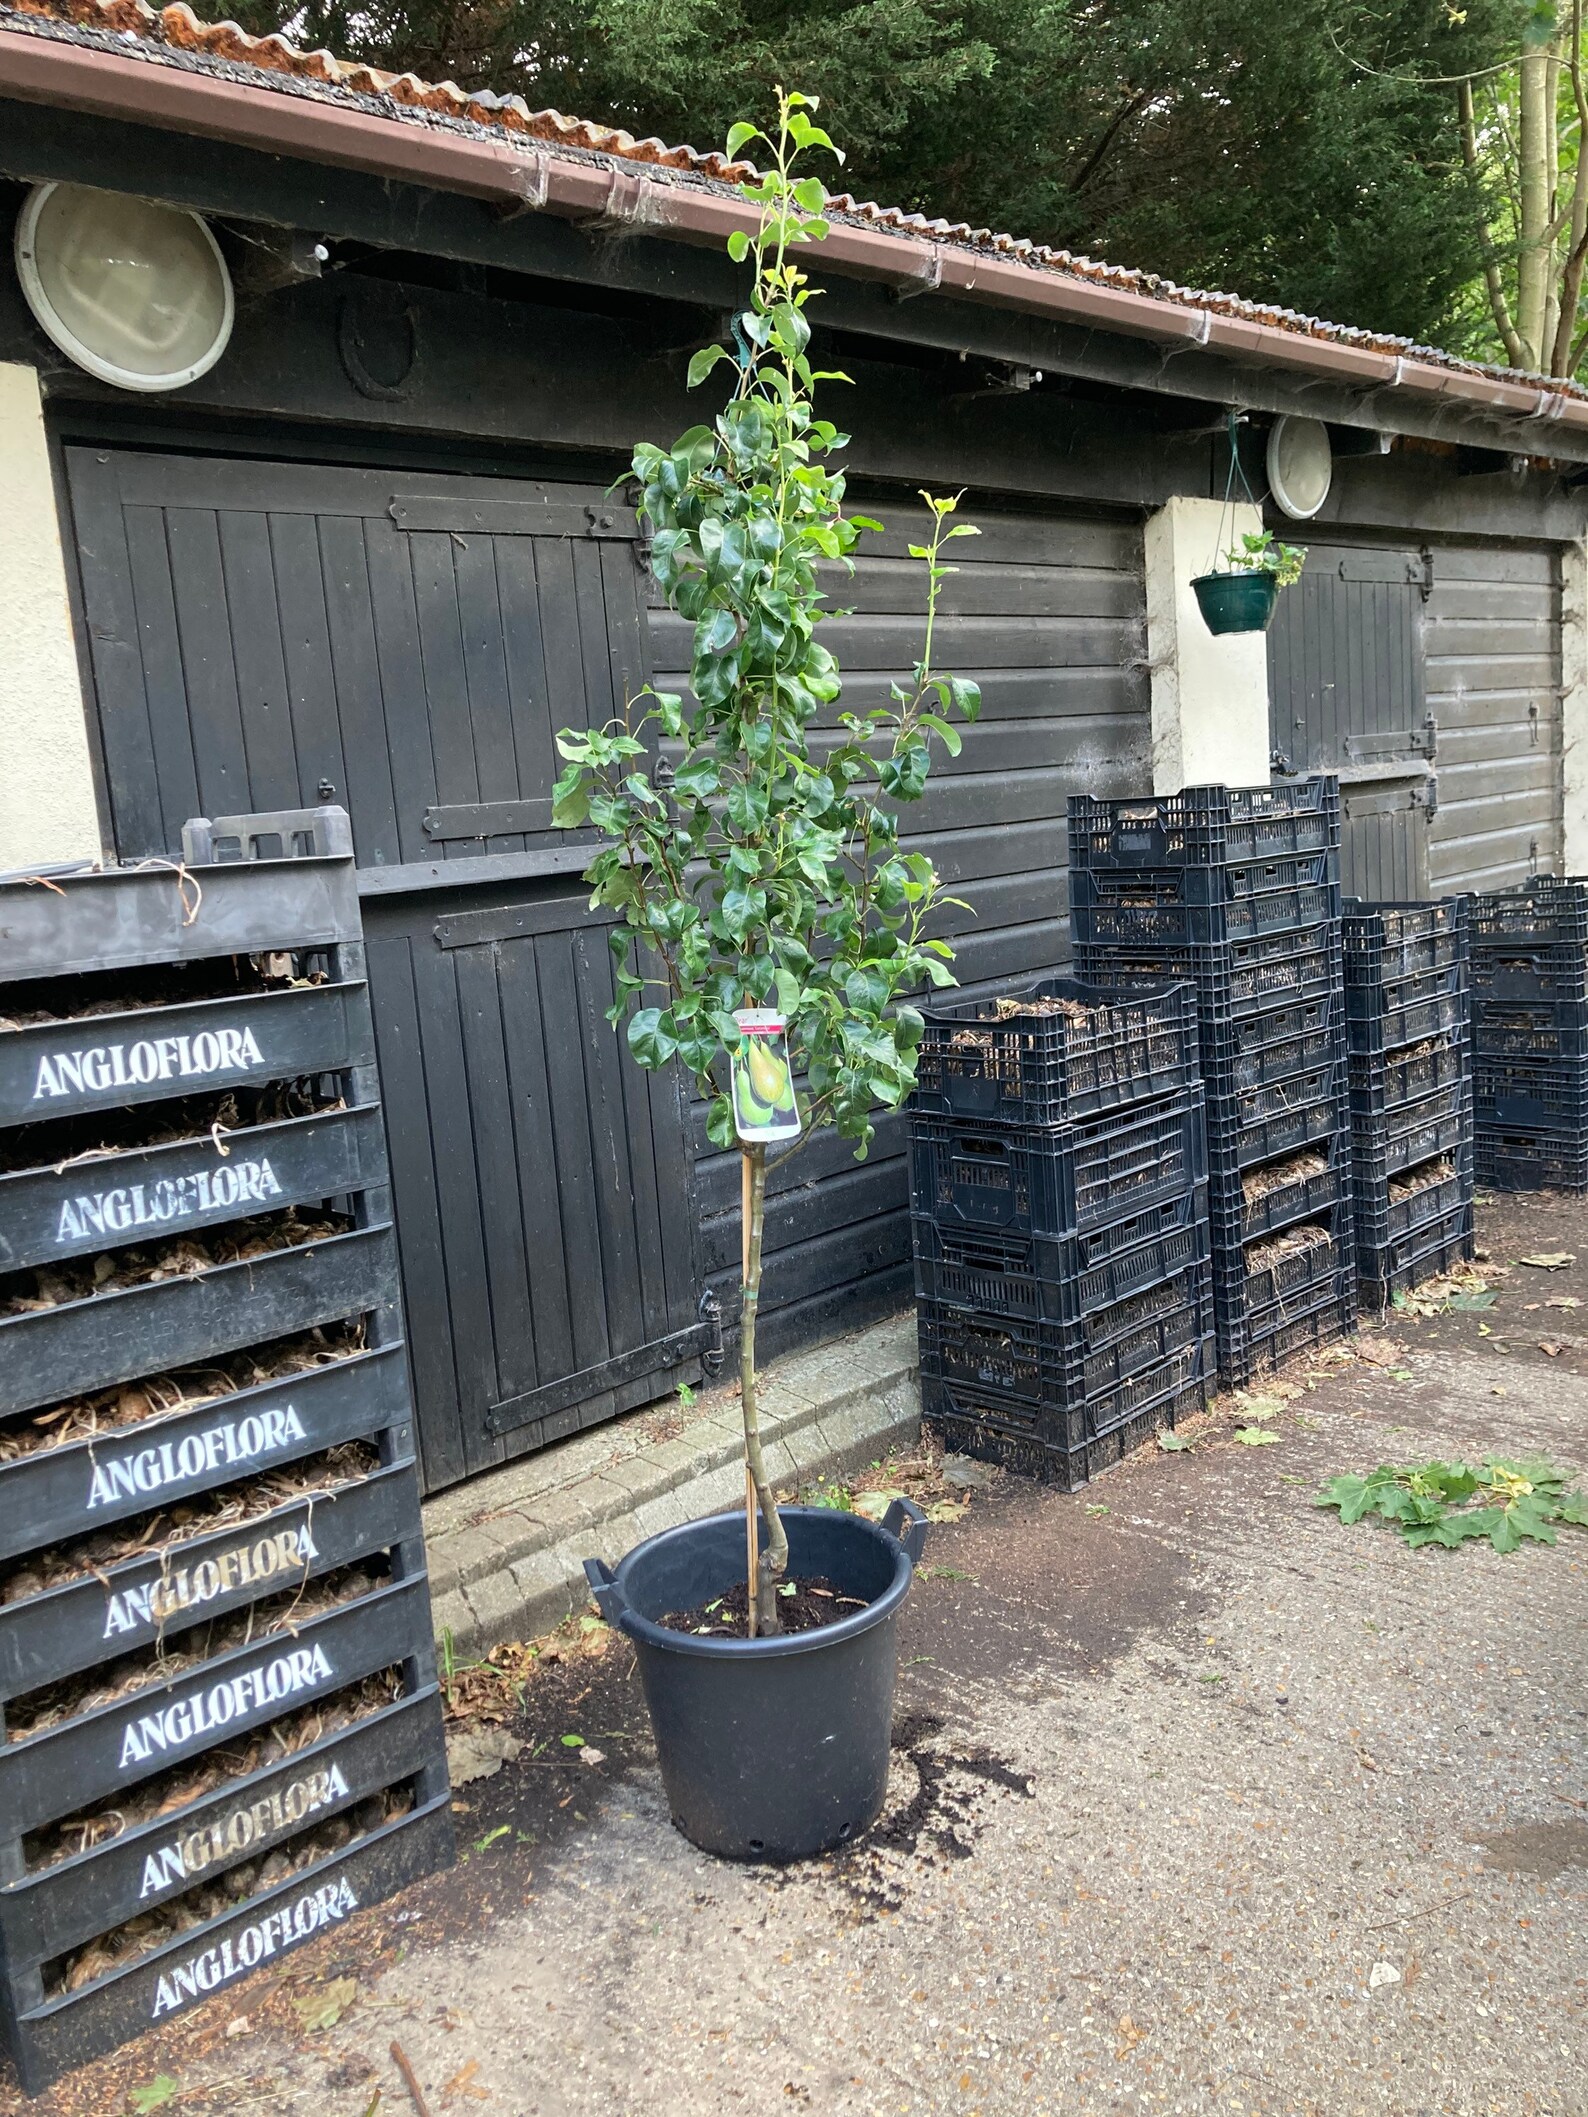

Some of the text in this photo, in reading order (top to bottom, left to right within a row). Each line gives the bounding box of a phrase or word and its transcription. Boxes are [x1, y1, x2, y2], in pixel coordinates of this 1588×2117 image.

[33, 1026, 265, 1099] ANGLOFLORA
[55, 1157, 282, 1242] ANGLOFLORA
[87, 1404, 307, 1509] ANGLOFLORA
[102, 1524, 319, 1639] ANGLOFLORA
[118, 1643, 333, 1768] ANGLOFLORA
[138, 1763, 350, 1898] ANGLOFLORA
[150, 1876, 358, 2018] ANGLOFLORA
